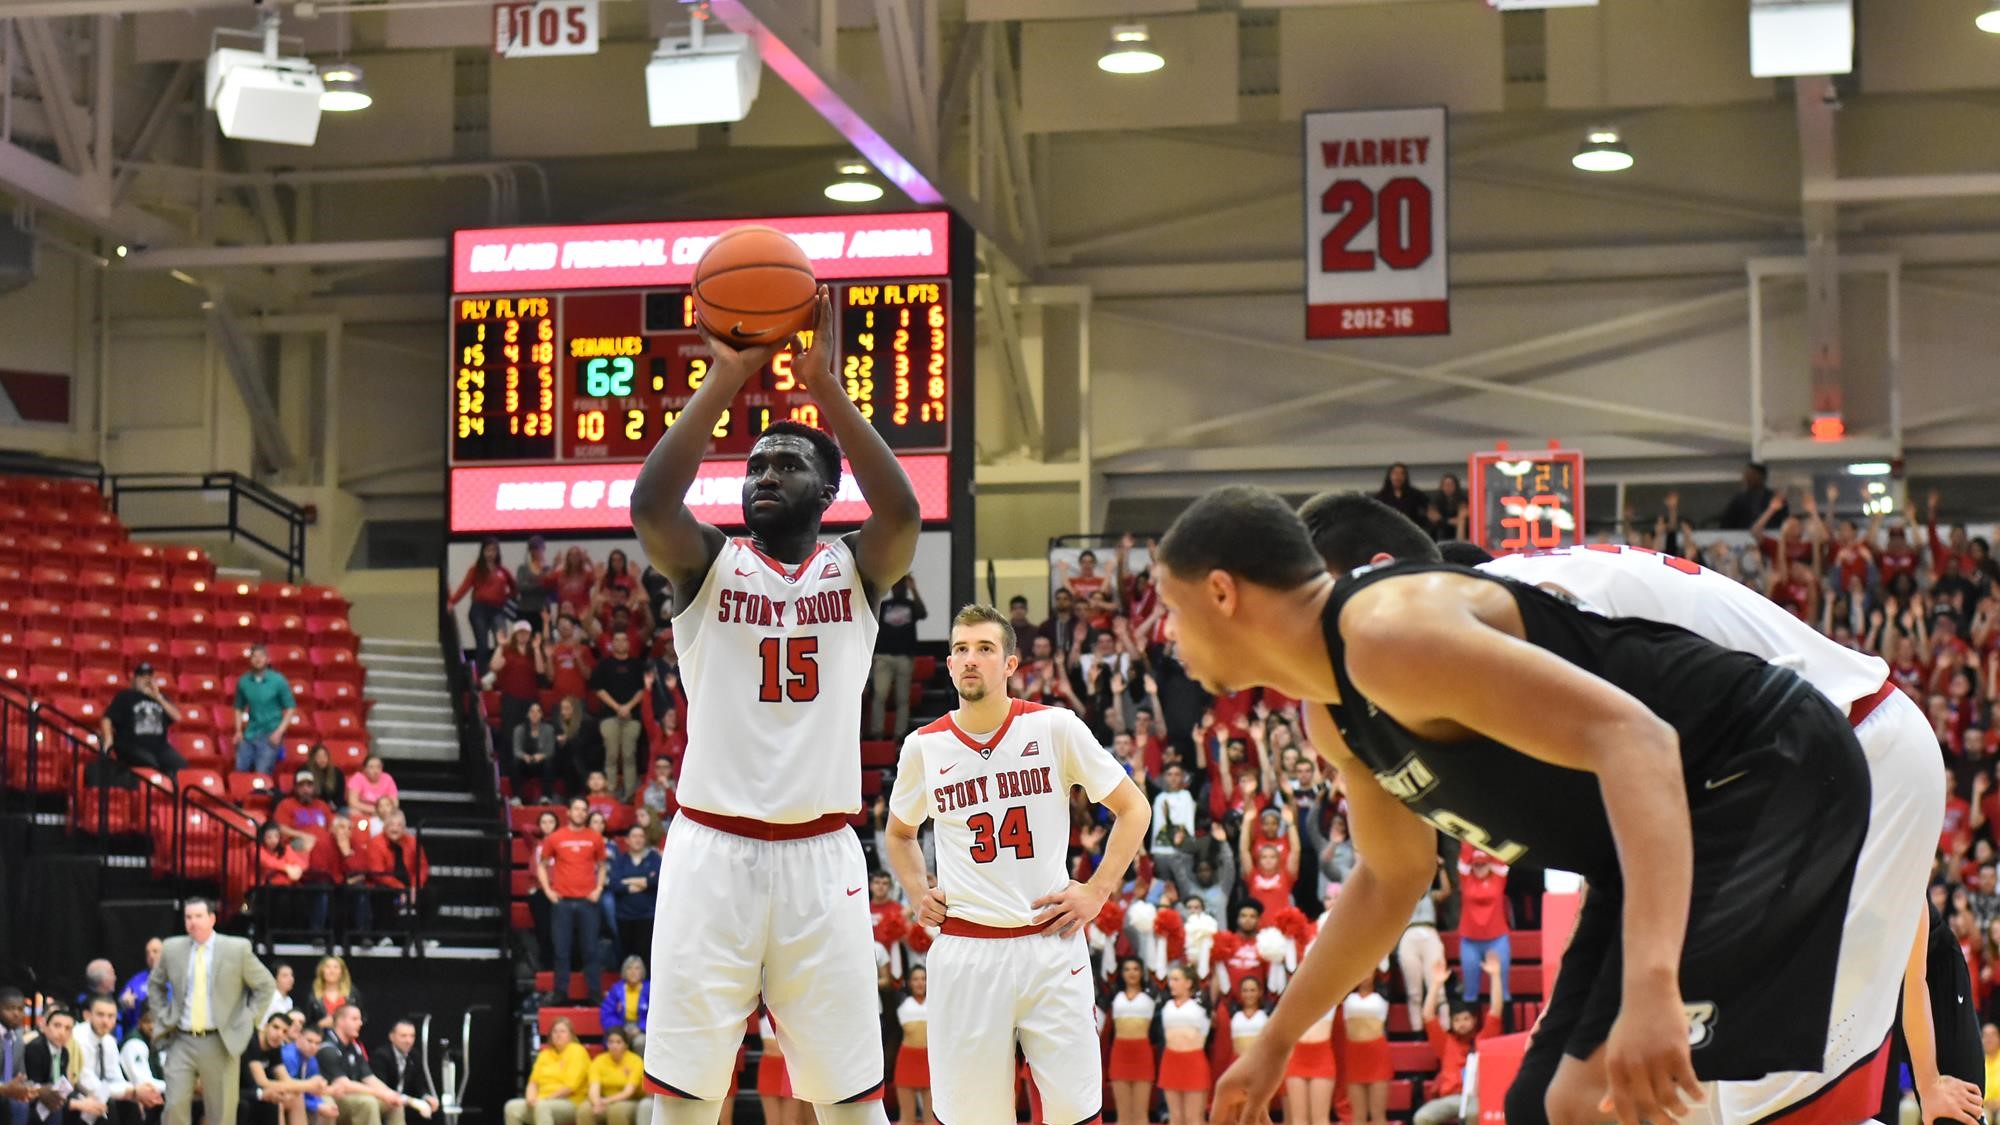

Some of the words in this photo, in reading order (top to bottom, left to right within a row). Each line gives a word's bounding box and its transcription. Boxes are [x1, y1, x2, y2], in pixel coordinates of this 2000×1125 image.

[520, 7, 586, 47] 105
[1320, 137, 1430, 169] WARNEY
[1321, 177, 1432, 273] 20
[928, 305, 944, 327] 6
[1342, 308, 1414, 329] 2012-16
[505, 320, 518, 342] 2
[539, 319, 552, 341] 6
[894, 329, 909, 352] 2
[931, 329, 944, 350] 3
[464, 344, 484, 366] 15
[844, 356, 873, 378] 22
[896, 354, 909, 377] 3
[928, 353, 944, 375] 2
[457, 368, 484, 390] 24
[507, 367, 518, 389] 3
[587, 357, 634, 397] 62
[772, 353, 800, 390] 5
[896, 377, 909, 400] 3
[928, 376, 944, 398] 8
[459, 391, 484, 413] 32
[506, 389, 518, 412] 3
[540, 389, 552, 411] 3
[893, 401, 909, 425] 2
[459, 415, 484, 438] 34
[524, 413, 552, 436] 23
[578, 411, 604, 441] 10
[625, 409, 644, 440] 2
[1501, 495, 1561, 548] 30
[718, 588, 786, 627] STONY
[795, 588, 853, 625] BROOK
[759, 636, 819, 702] 15
[934, 776, 989, 813] STONY
[996, 767, 1053, 799] BROOK
[966, 806, 1034, 863] 34
